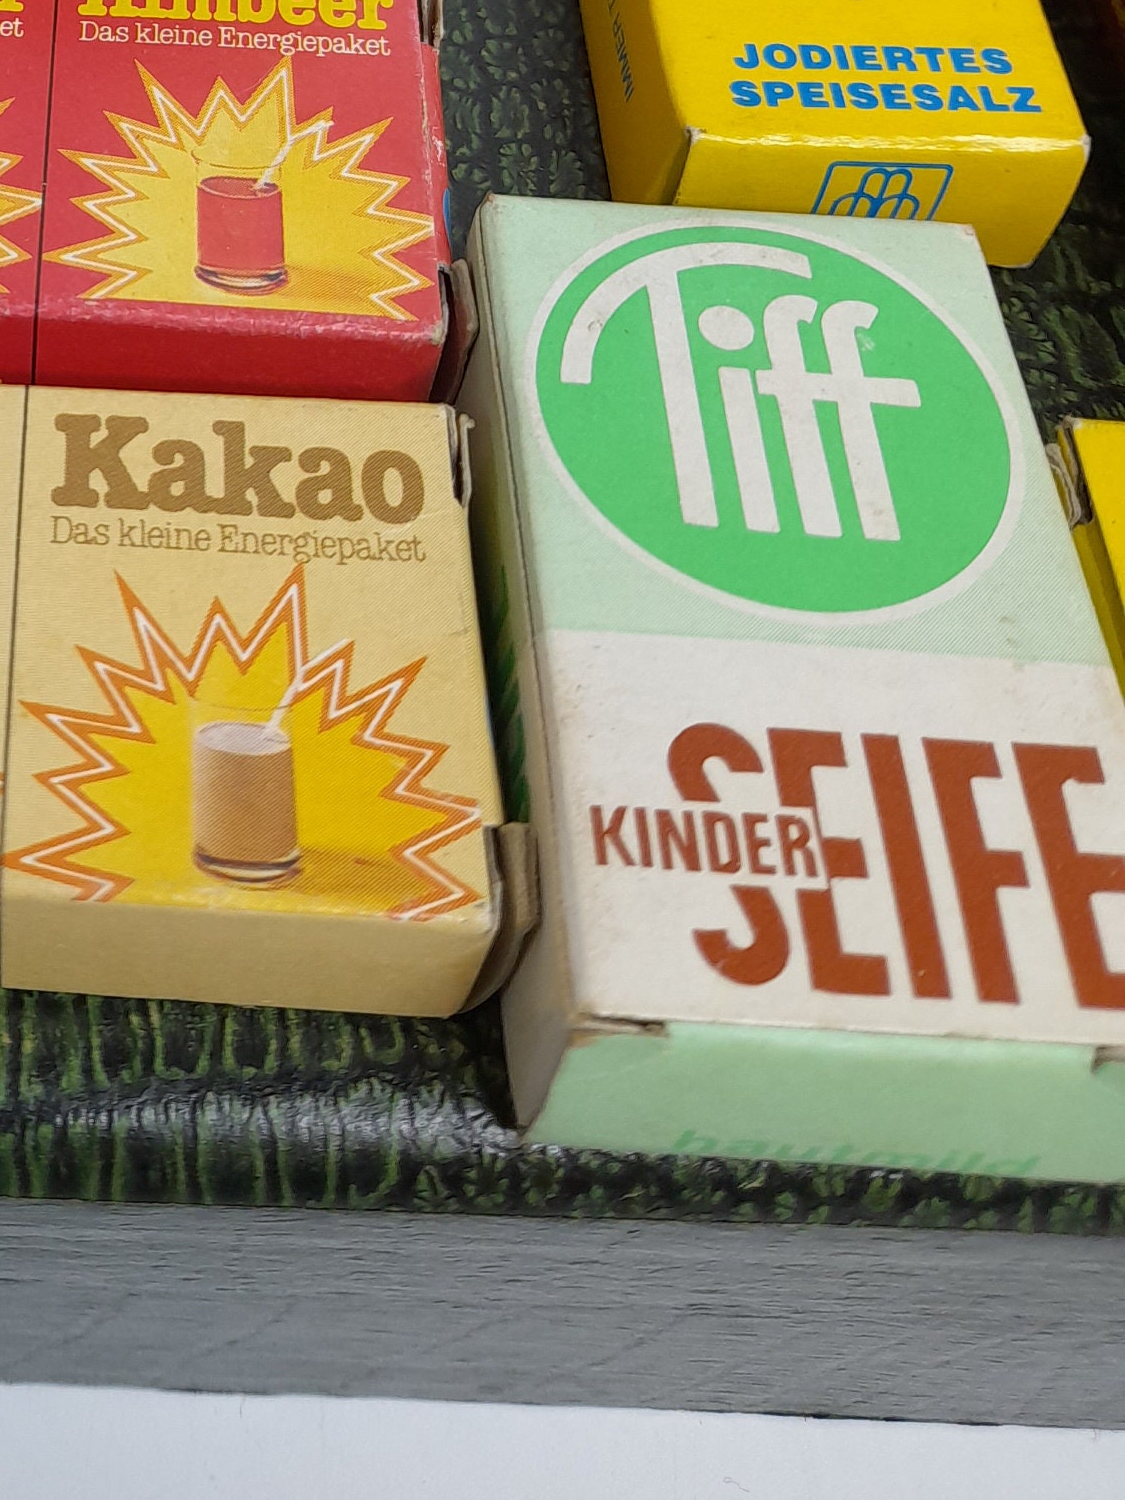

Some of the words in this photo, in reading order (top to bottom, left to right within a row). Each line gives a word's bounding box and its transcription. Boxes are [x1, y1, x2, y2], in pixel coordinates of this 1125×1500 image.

[79, 21, 129, 42] Das
[135, 22, 212, 47] kleine
[218, 26, 391, 57] Energiepaket
[732, 42, 1013, 75] JODIERTES
[729, 81, 1041, 113] SPEISESALZ
[559, 240, 921, 542] Tiff
[50, 412, 425, 526] Kakao
[50, 515, 111, 546] Das
[118, 518, 211, 552] kleine
[217, 523, 427, 566] Energiepaket
[589, 805, 819, 878] KINDER
[668, 722, 1125, 1011] SEIFE
